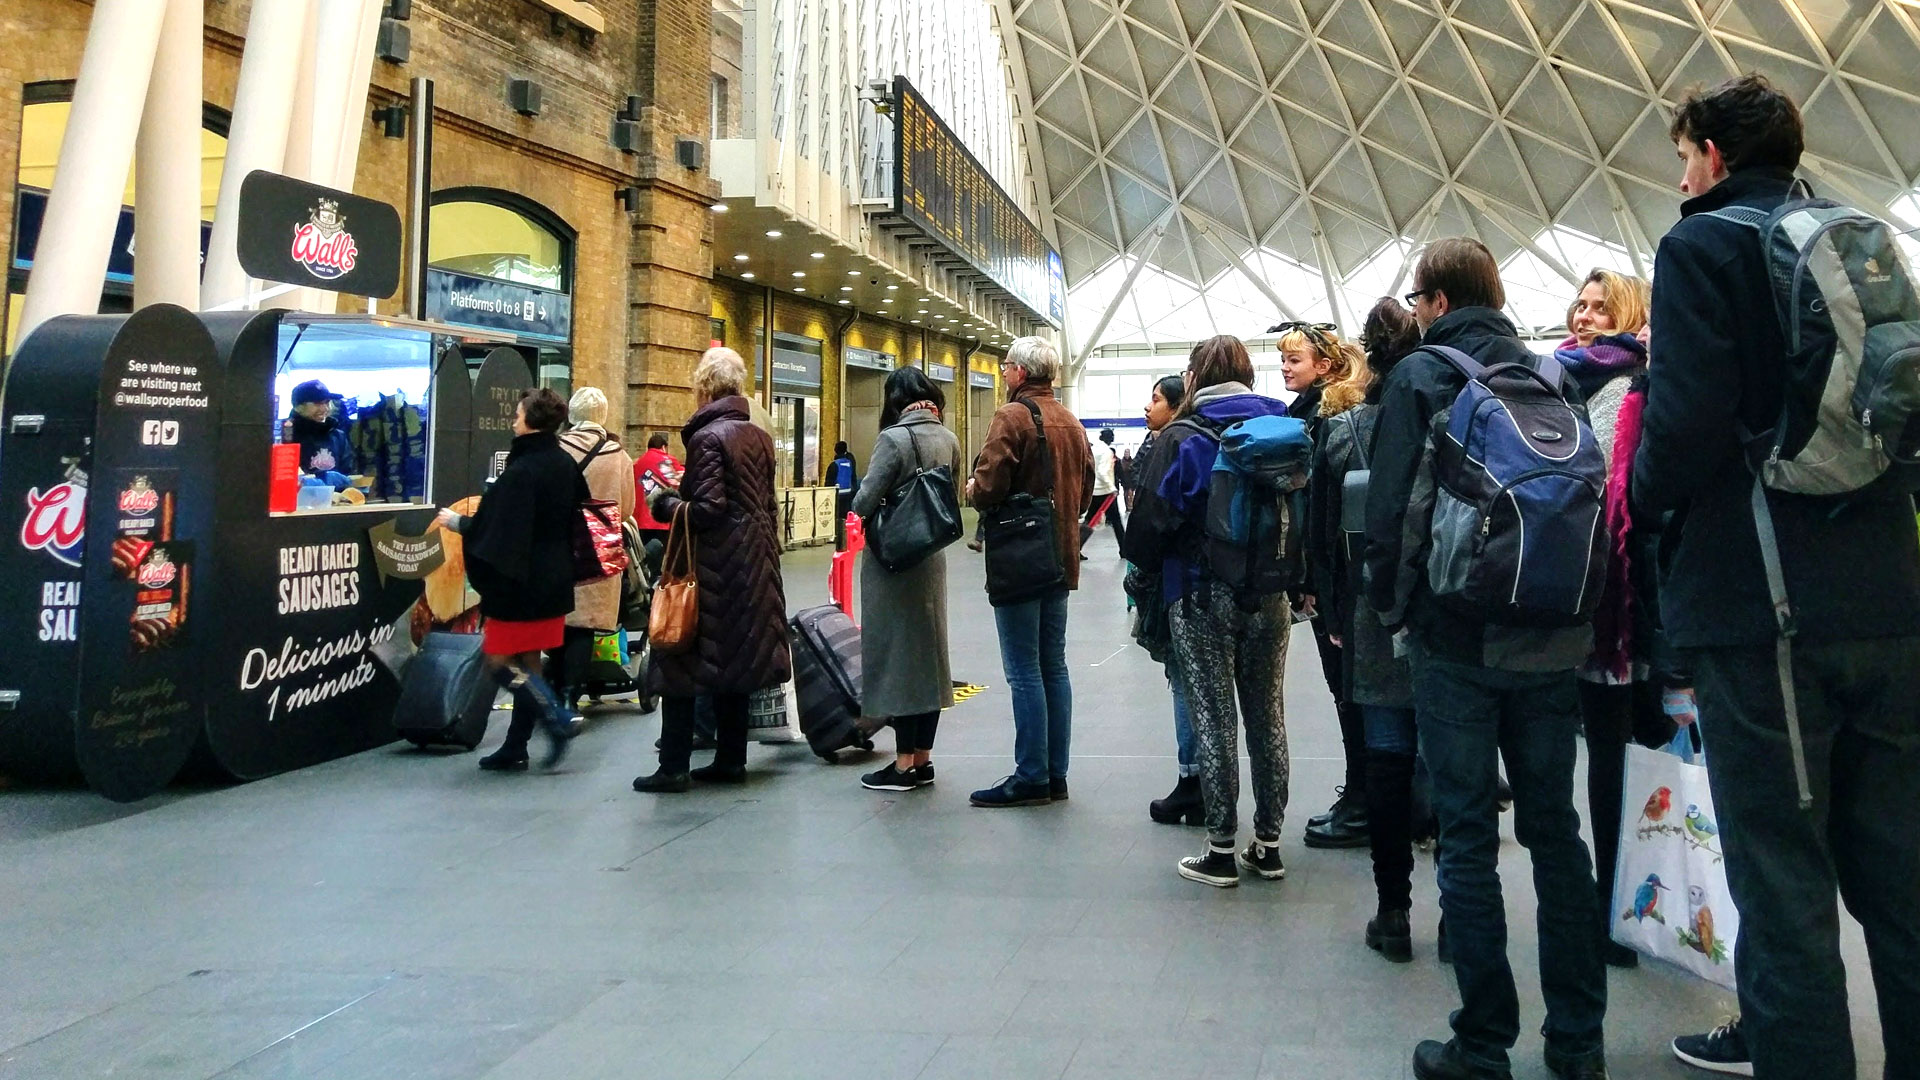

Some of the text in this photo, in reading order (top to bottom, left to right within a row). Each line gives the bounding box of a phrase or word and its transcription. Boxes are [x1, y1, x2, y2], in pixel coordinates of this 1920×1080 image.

[292, 222, 358, 273] Wall's
[450, 290, 520, 316] Platforms 0 to 8
[128, 359, 197, 376] See where we
[121, 376, 202, 392] are visiting next
[115, 391, 209, 408] @wallsproperfood
[490, 386, 520, 402] TRY IT
[498, 402, 512, 416] TO
[478, 416, 516, 431] BELIEV
[376, 540, 440, 563] SAUSAGE SANDWICH
[392, 539, 427, 552] TRY A FREE
[280, 542, 359, 575] READY BAKED
[396, 562, 420, 573] TODAY
[278, 571, 360, 615] SAUSAGES
[241, 617, 396, 691] Delicious in
[267, 654, 376, 721] 1 minute
